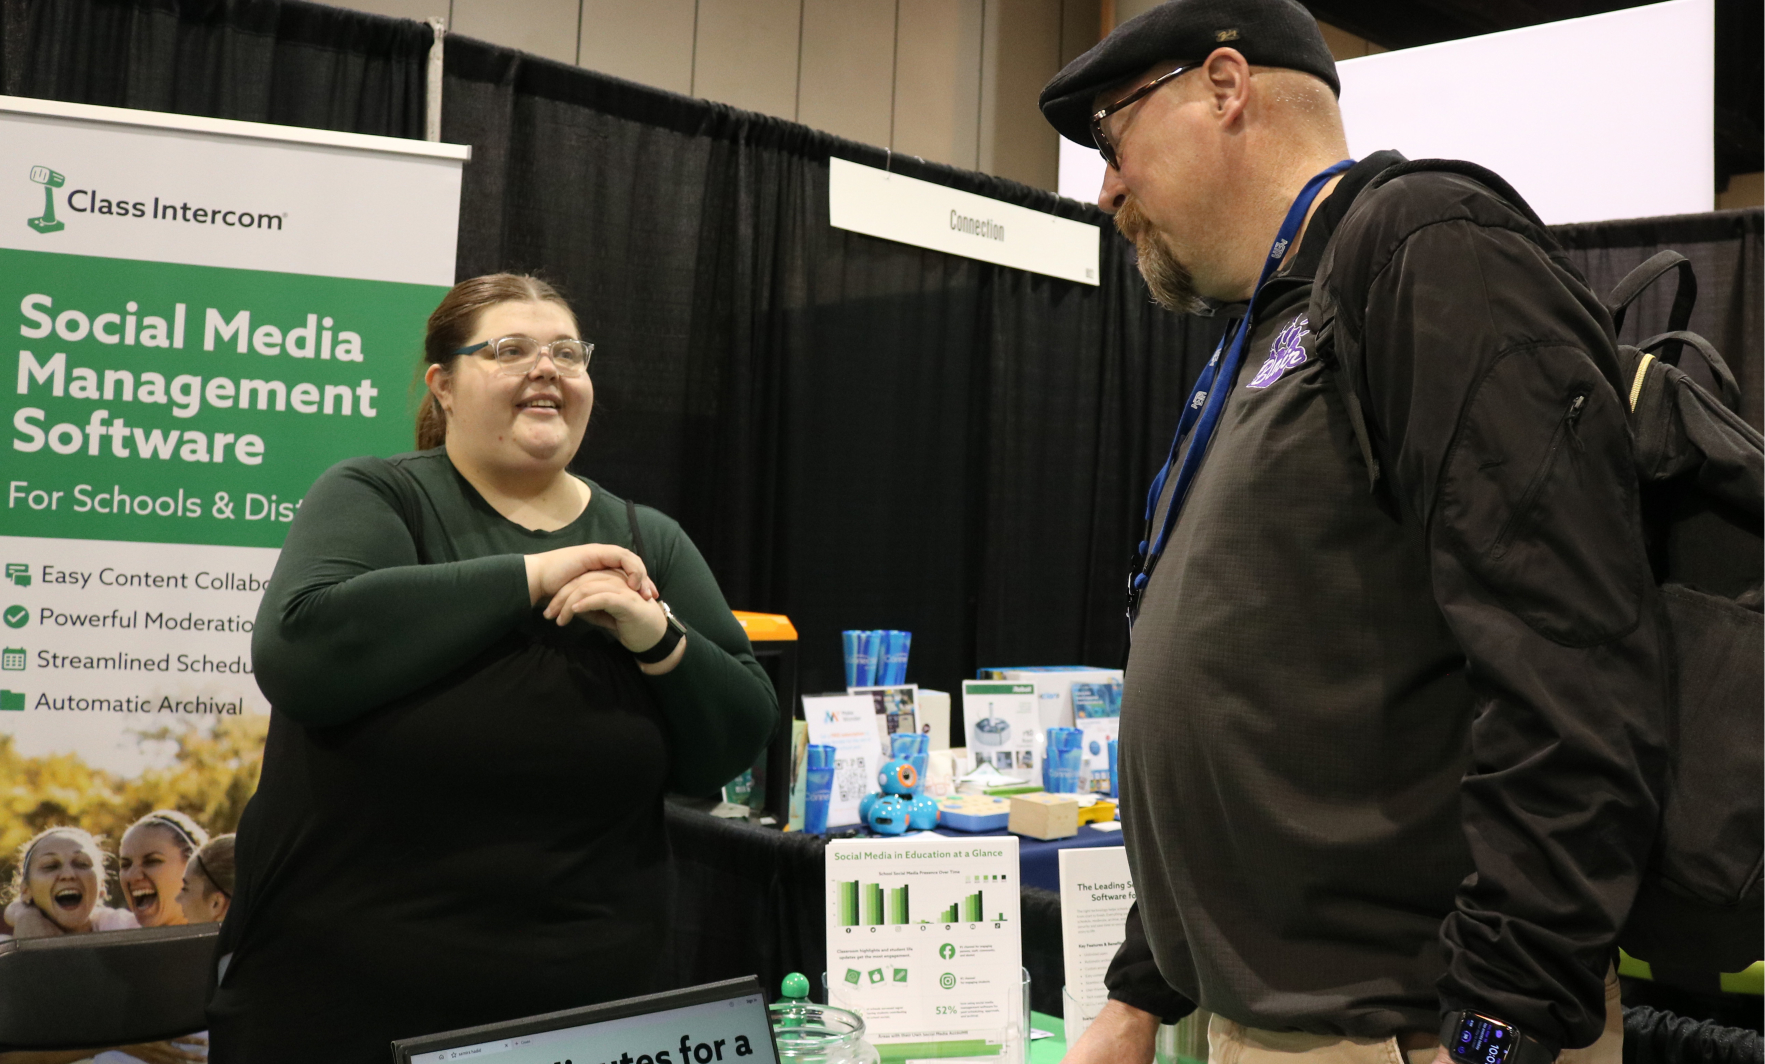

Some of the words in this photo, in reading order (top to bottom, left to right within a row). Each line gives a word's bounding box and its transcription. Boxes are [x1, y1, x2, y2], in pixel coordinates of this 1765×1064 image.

[67, 189, 146, 218] Class
[153, 197, 283, 230] Intercom
[950, 209, 1005, 242] Connection
[19, 293, 187, 349] Social
[203, 307, 364, 362] Media
[16, 350, 379, 419] Management
[12, 406, 266, 466] Software
[8, 480, 64, 511] For
[72, 483, 202, 518] Schools
[211, 491, 236, 520] &
[42, 565, 92, 590] Easy
[98, 567, 189, 589] Content
[39, 608, 137, 630] Powerful
[144, 611, 254, 634] Moderatio
[37, 650, 170, 671] Streamlined
[176, 654, 254, 674] Schedu
[34, 692, 152, 713] Automatic
[157, 695, 243, 716] Archival
[834, 852, 862, 861] Social
[864, 851, 892, 860] Media
[894, 851, 903, 859] in
[905, 850, 951, 859] Education
[953, 850, 962, 858] at
[972, 849, 1003, 858] Glance
[1077, 883, 1092, 891] The
[1094, 881, 1125, 890] Leading
[1091, 893, 1126, 901] Software
[936, 1006, 957, 1015] 52%
[679, 1034, 726, 1064] for
[734, 1035, 754, 1057] a
[1485, 1044, 1500, 1064] 10:0
